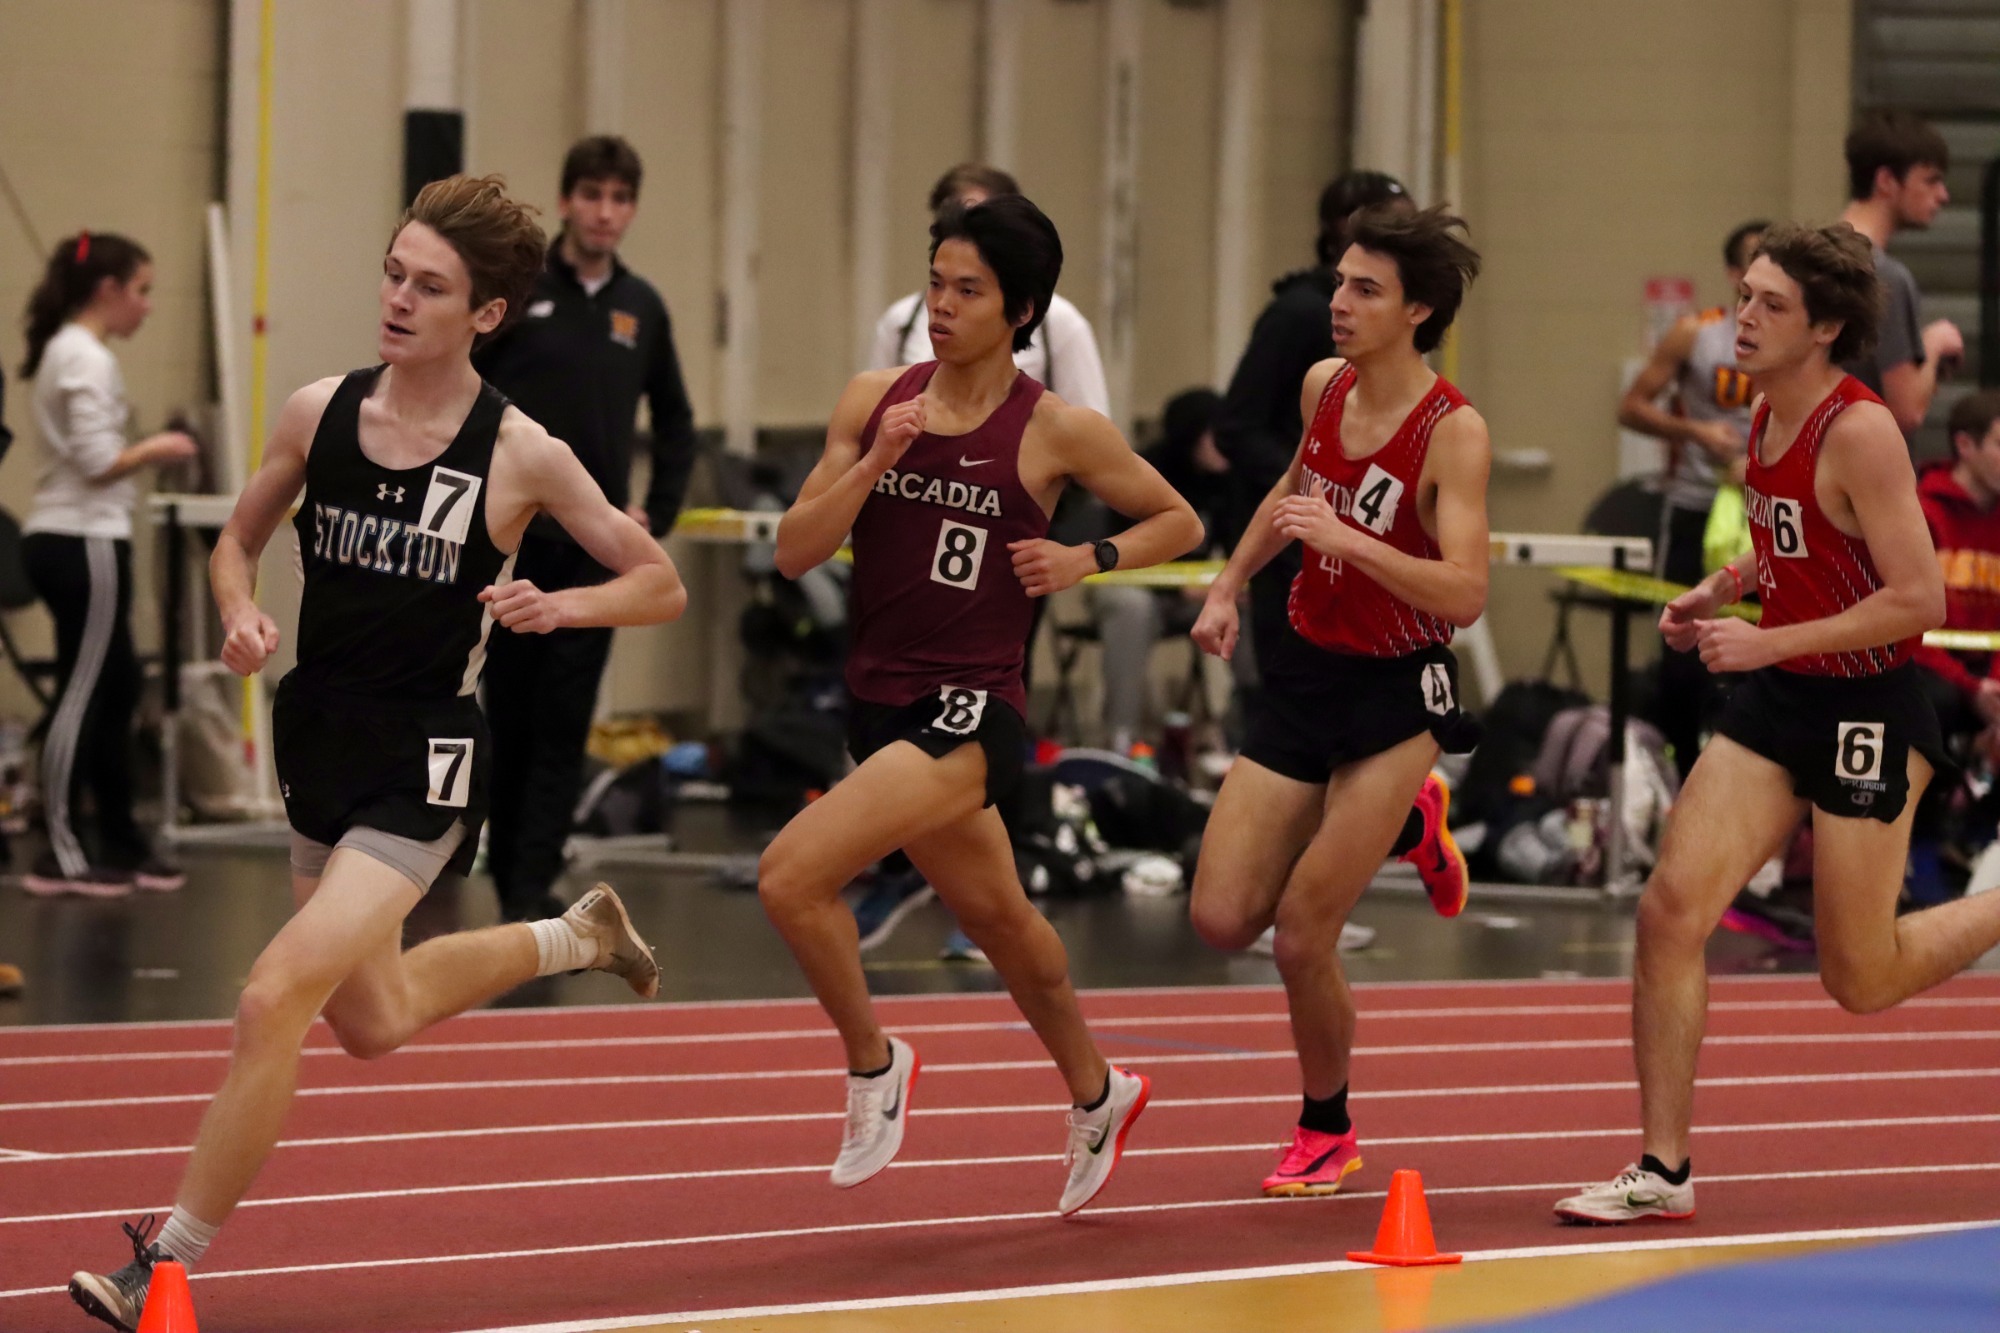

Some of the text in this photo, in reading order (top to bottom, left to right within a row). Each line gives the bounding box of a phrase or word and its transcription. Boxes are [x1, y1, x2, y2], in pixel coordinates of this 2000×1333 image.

[427, 471, 472, 532] 7
[873, 469, 1002, 517] RCADIA
[1358, 477, 1392, 526] 4
[314, 502, 462, 584] STOCKTON
[1774, 502, 1798, 554] 6
[938, 527, 977, 583] 8
[943, 688, 978, 730] 8
[1429, 664, 1447, 711] 4
[434, 744, 466, 801] 7
[1842, 727, 1875, 775] 6
